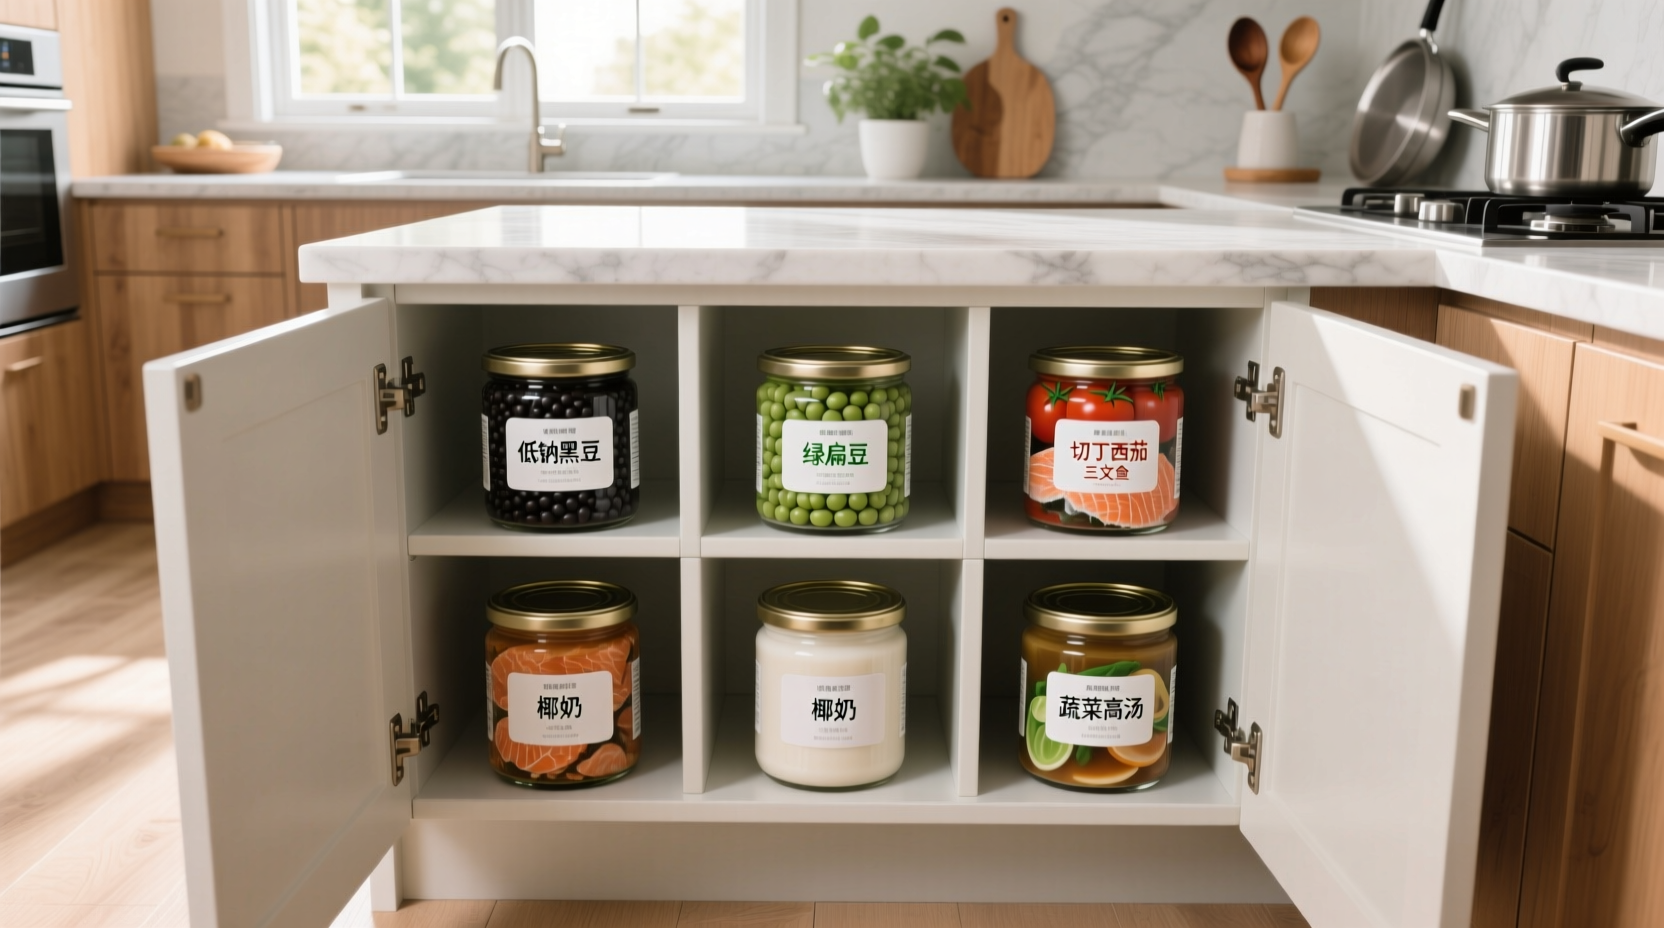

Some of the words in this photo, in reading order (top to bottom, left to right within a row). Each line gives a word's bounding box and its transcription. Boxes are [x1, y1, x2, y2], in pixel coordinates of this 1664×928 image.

[518, 440, 601, 464] 低钠黑豆
[803, 442, 868, 466] 绿扁豆
[1070, 440, 1148, 462] 切丁西茄
[537, 695, 582, 720] 椰奶
[811, 697, 856, 722] 椰奶
[1059, 695, 1143, 720] 蔬菜高汤
